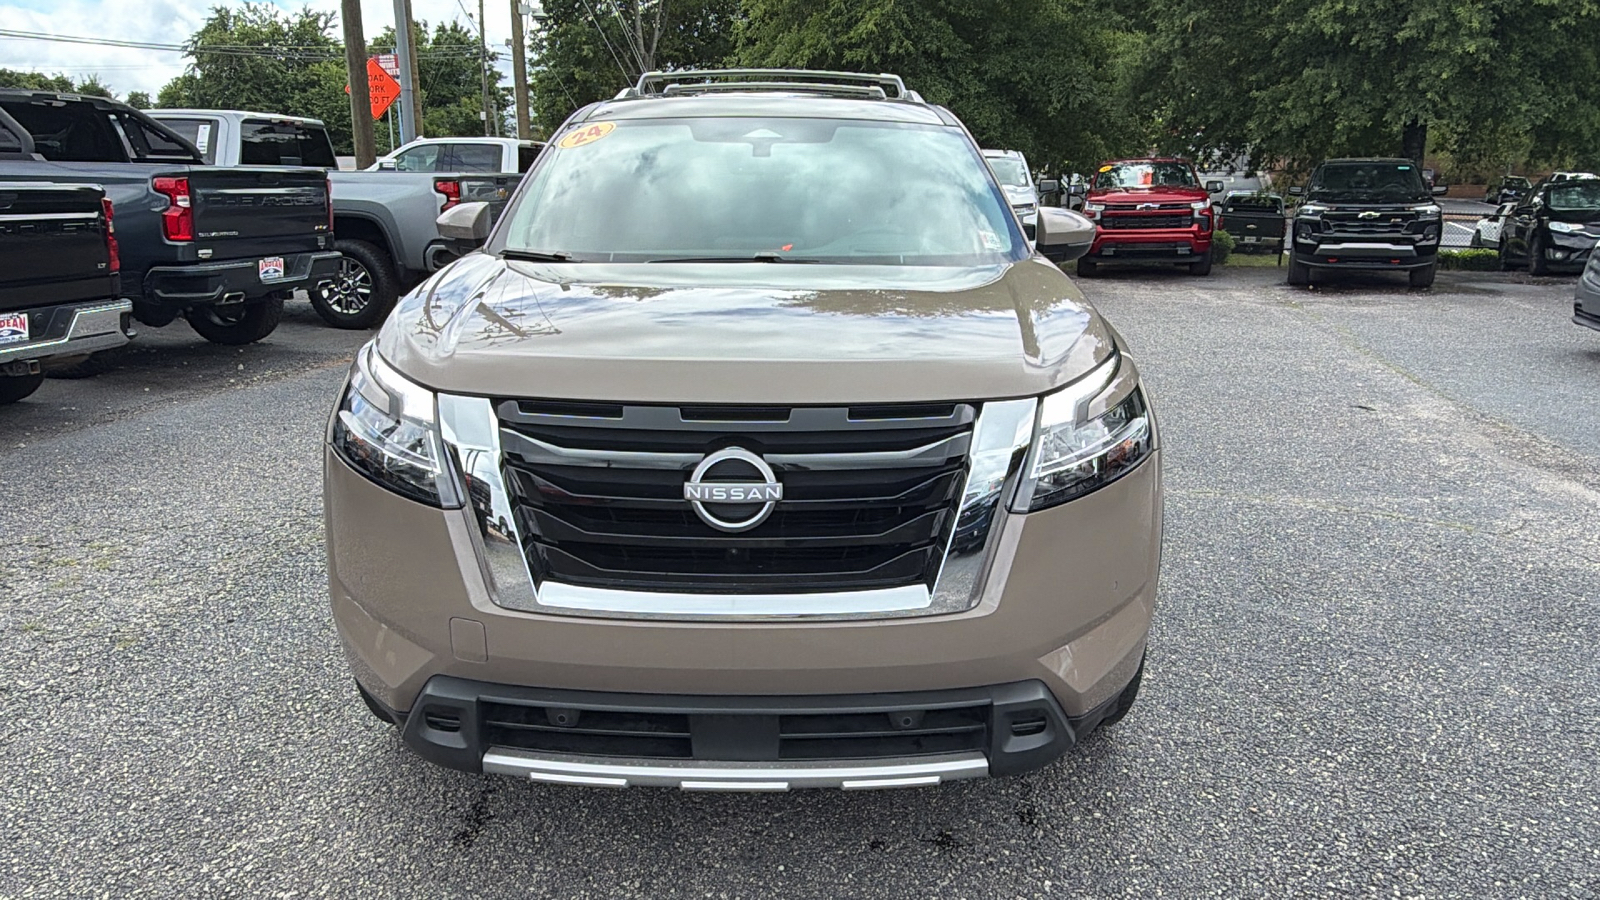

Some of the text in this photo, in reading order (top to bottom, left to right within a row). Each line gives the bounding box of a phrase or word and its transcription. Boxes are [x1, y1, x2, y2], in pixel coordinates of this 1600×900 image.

[369, 85, 386, 93] ORK
[571, 125, 604, 146] 24
[686, 486, 780, 500] NISSAN
